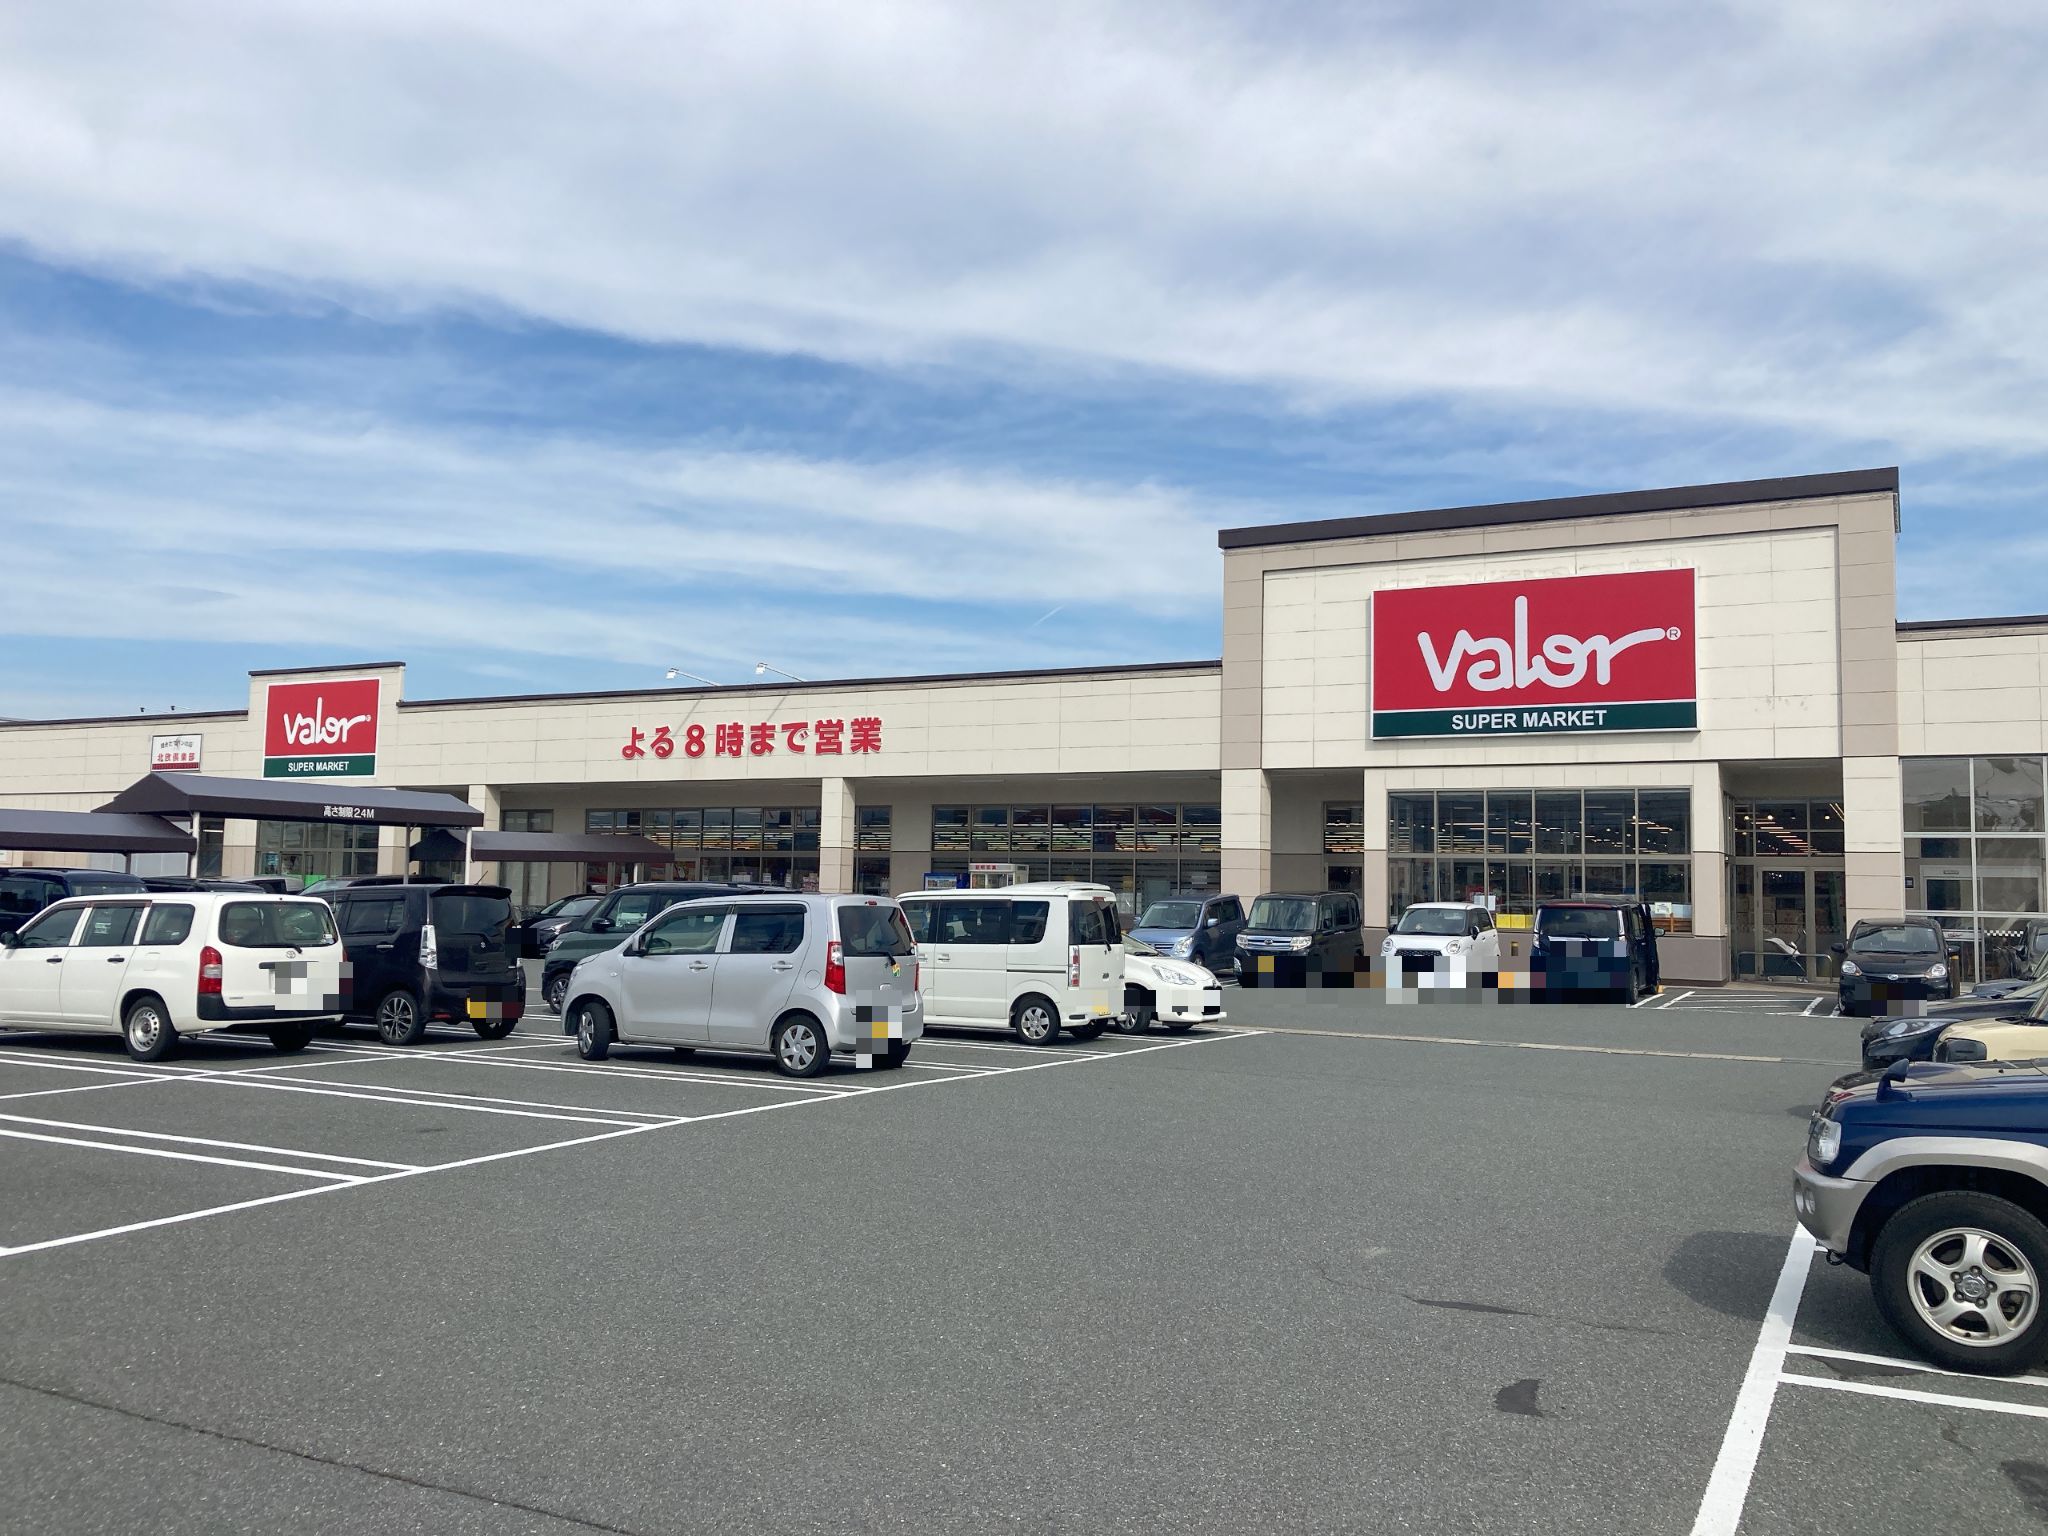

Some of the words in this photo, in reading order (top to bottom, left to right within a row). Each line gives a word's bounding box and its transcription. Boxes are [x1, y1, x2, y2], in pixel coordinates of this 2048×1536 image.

[1451, 711, 1518, 730] SUPER
[1522, 709, 1608, 728] MARKET
[621, 716, 883, 760] よる8時まで営業
[287, 762, 314, 772] SUPER
[315, 761, 350, 771] MARKET
